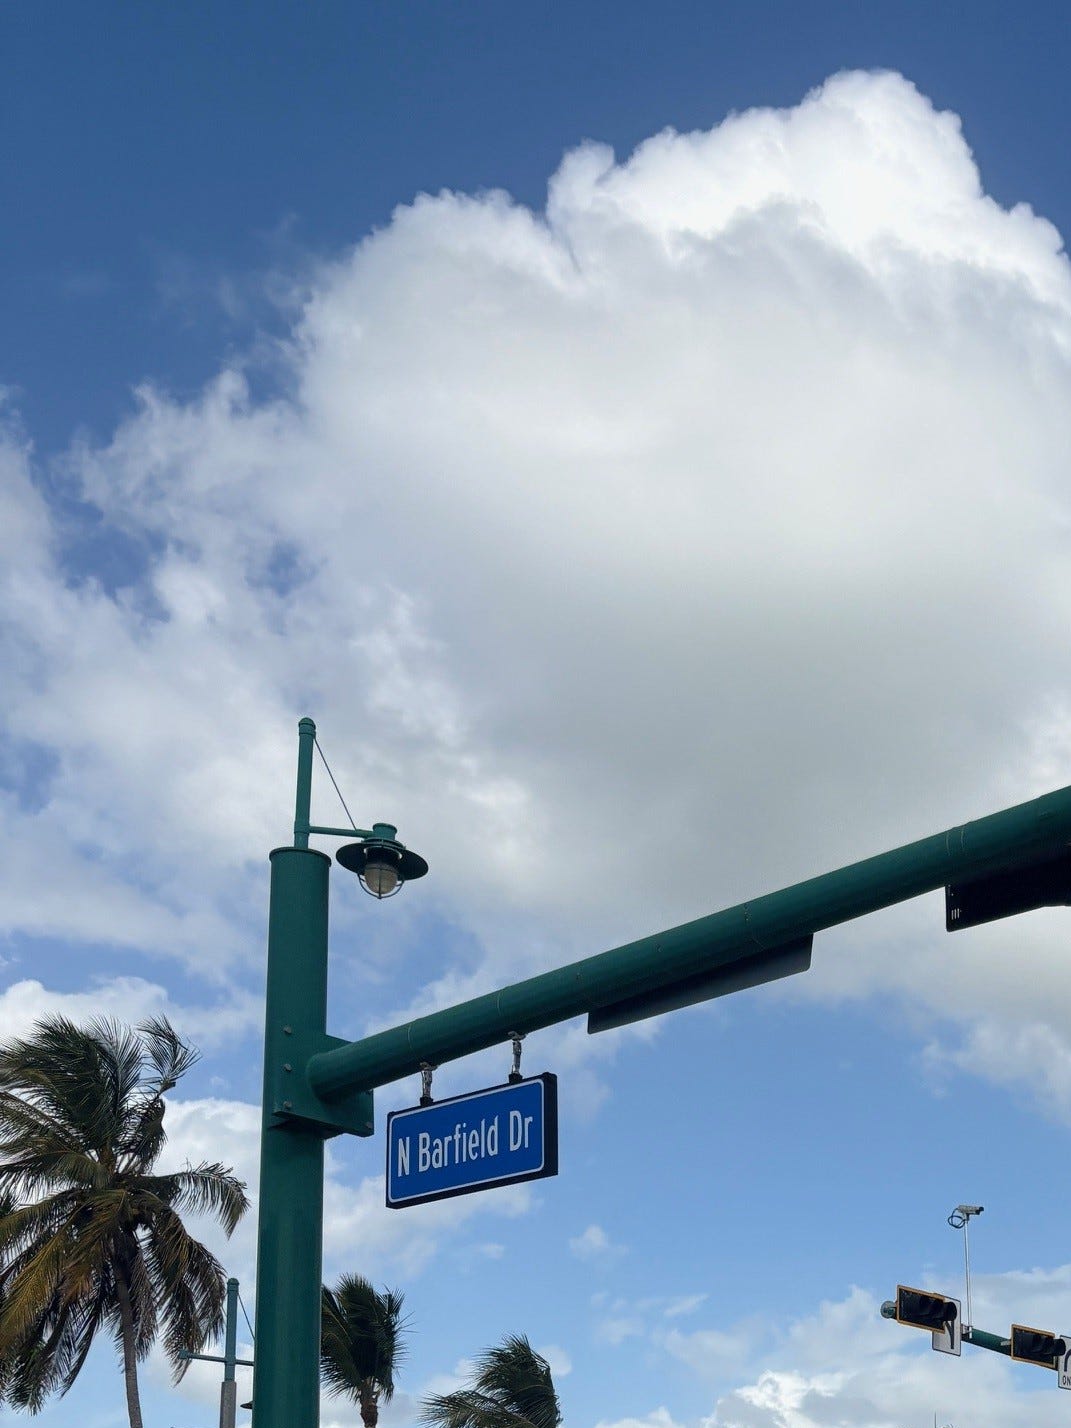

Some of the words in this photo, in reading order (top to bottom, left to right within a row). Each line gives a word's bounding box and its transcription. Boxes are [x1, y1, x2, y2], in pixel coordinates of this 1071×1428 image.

[397, 1136, 410, 1177] N
[418, 1115, 499, 1173] Barfield
[509, 1110, 533, 1152] Dr
